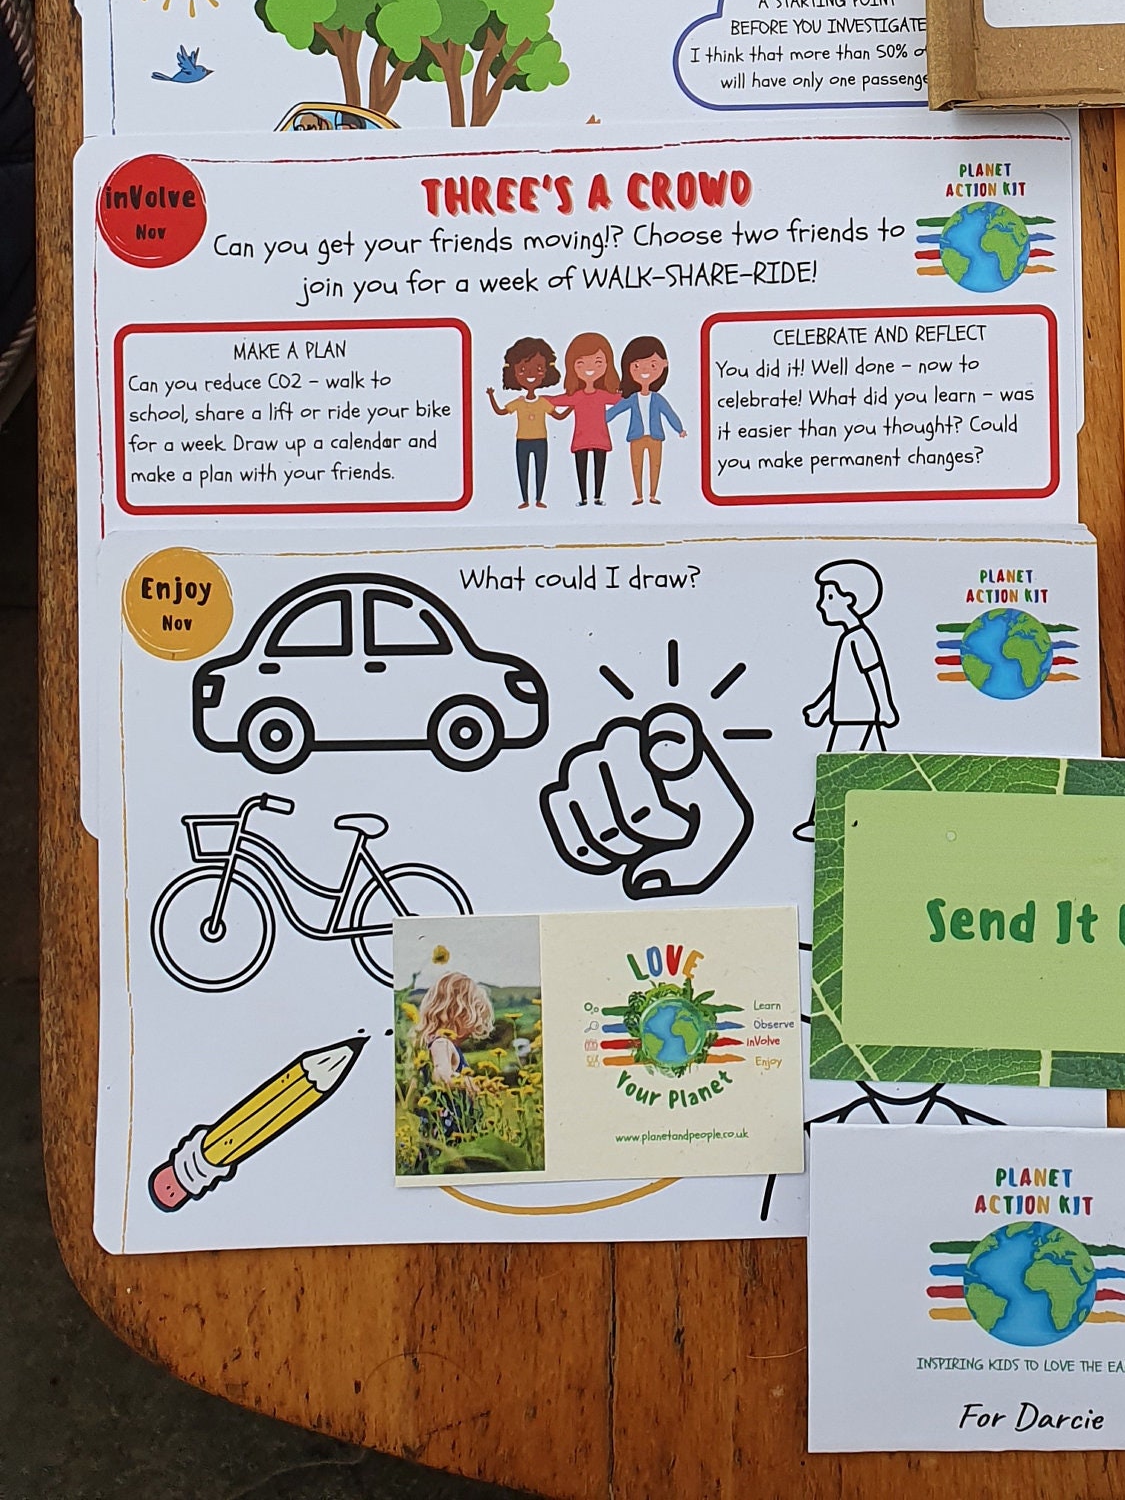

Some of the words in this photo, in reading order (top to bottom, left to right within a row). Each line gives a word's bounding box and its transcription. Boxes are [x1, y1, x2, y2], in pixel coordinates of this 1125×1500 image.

[959, 162, 1012, 178] PLANET
[105, 184, 196, 211] inVolve
[420, 173, 573, 217] THREE'S
[587, 173, 612, 211] A
[626, 169, 752, 211] CROWD
[945, 182, 997, 198] ACTION
[1002, 181, 1026, 197] KIT
[135, 224, 166, 241] Nov
[773, 326, 868, 346] CELEBRATE
[874, 324, 909, 344] AND
[915, 324, 987, 343] REFLECT
[233, 342, 280, 361] MAKE
[287, 341, 299, 360] A
[305, 339, 346, 360] PLAN
[717, 458, 751, 477] you
[758, 450, 803, 469] make
[810, 447, 901, 475] permanent
[907, 445, 984, 472] changes?
[459, 565, 526, 592] What
[535, 564, 596, 591] could
[605, 565, 620, 589] I
[628, 564, 701, 590] draw?
[141, 576, 212, 607] Enjoy
[162, 614, 193, 632] Nov
[926, 897, 1036, 944] Send
[1056, 899, 1099, 945] It
[624, 943, 706, 982] LOVE
[753, 999, 782, 1011] Learn
[753, 1019, 795, 1030] Observe
[746, 1034, 781, 1047] inVolve
[755, 1055, 783, 1071] Enjoy
[616, 1068, 662, 1106] Your
[668, 1070, 733, 1110] Planet
[615, 1127, 750, 1145] www.planetandpeople.co.uk
[995, 1167, 1073, 1189] PLANET
[974, 1194, 1050, 1216] ACTION
[1059, 1194, 1094, 1216] KIT
[916, 1356, 984, 1371] INSPIRING
[988, 1358, 1021, 1372] KIDS
[1023, 1359, 1040, 1371] TO
[1043, 1359, 1075, 1372] LOVE
[1079, 1360, 1103, 1373] THE
[958, 1403, 1007, 1429] For
[1014, 1401, 1105, 1433] Darcie
